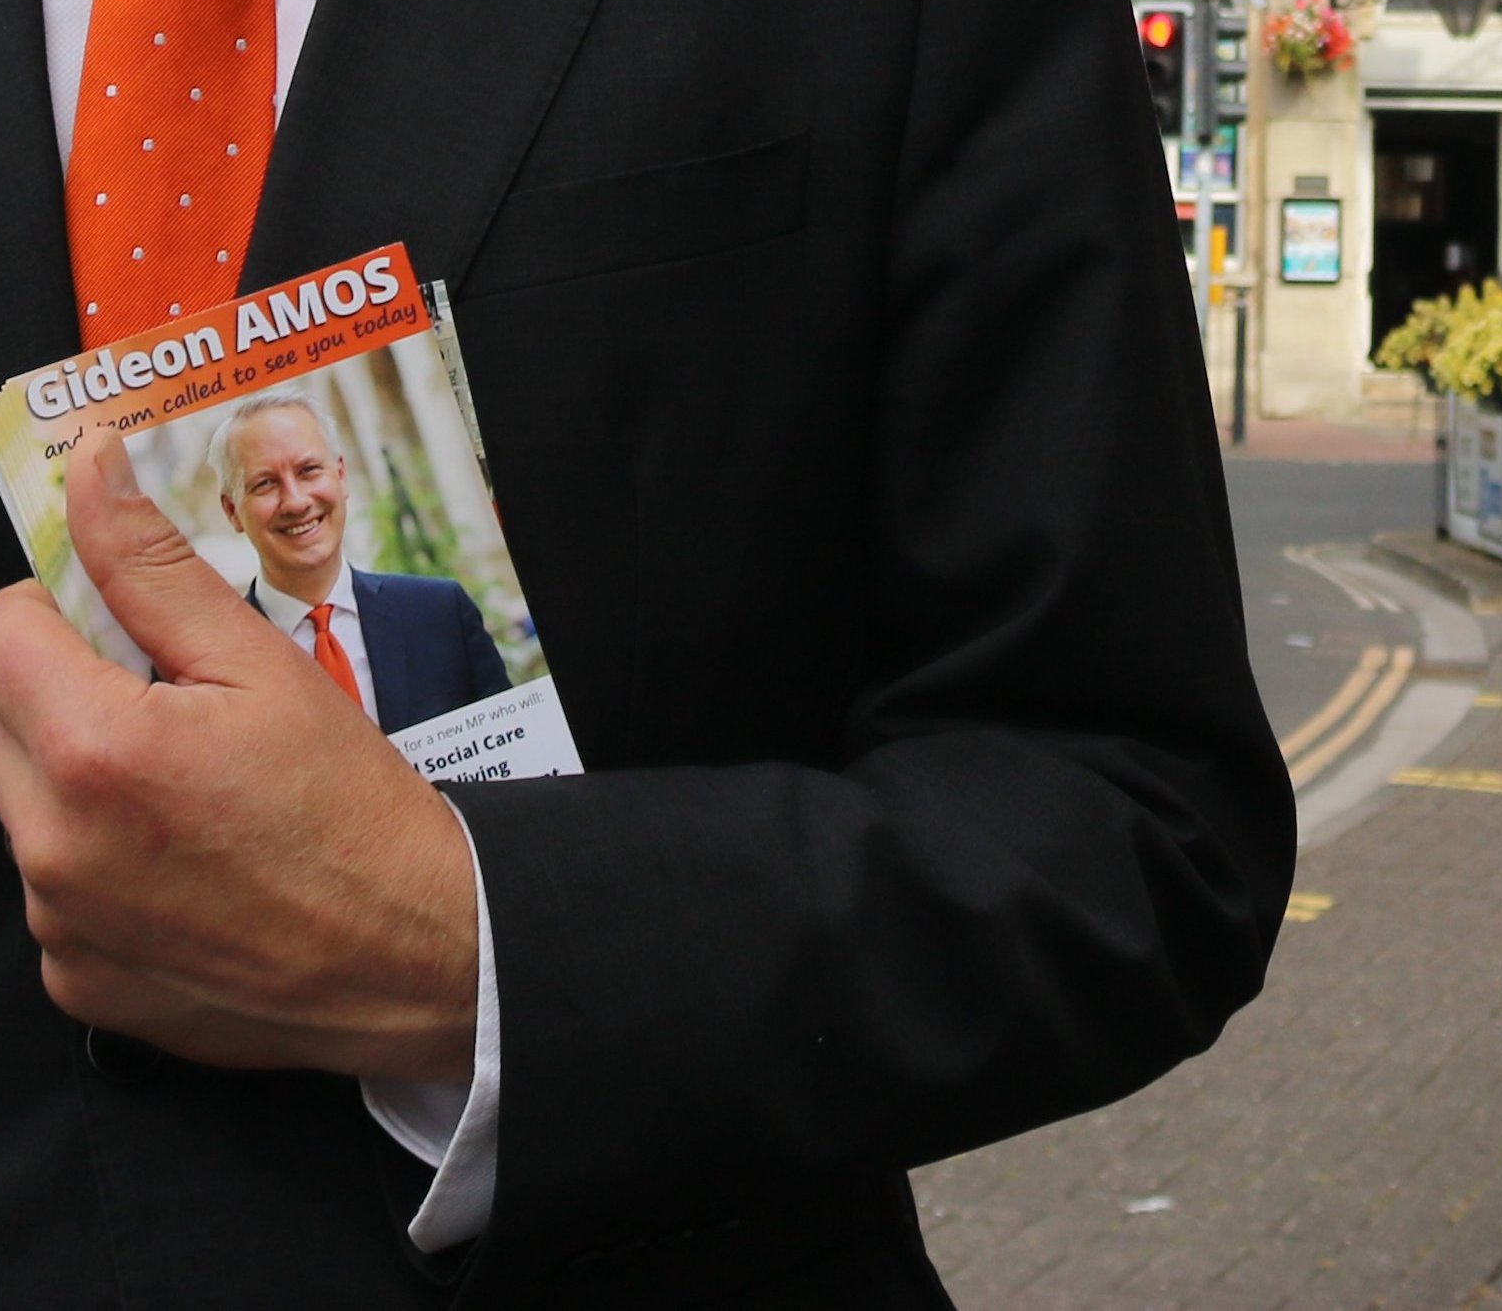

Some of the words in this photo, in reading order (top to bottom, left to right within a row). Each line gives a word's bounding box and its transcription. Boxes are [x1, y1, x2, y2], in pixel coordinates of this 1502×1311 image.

[26, 325, 225, 420] Gideon
[236, 256, 400, 354] AMOS
[97, 406, 155, 433] am
[162, 378, 227, 415] called
[232, 365, 258, 386] to
[264, 348, 299, 376] see
[306, 331, 346, 364] you
[352, 302, 418, 339] today
[403, 739, 423, 755] for
[426, 734, 436, 746] a
[437, 722, 465, 741] new
[465, 712, 487, 732] MP
[489, 700, 518, 721] who
[424, 740, 482, 775] Social
[482, 725, 527, 753] Care
